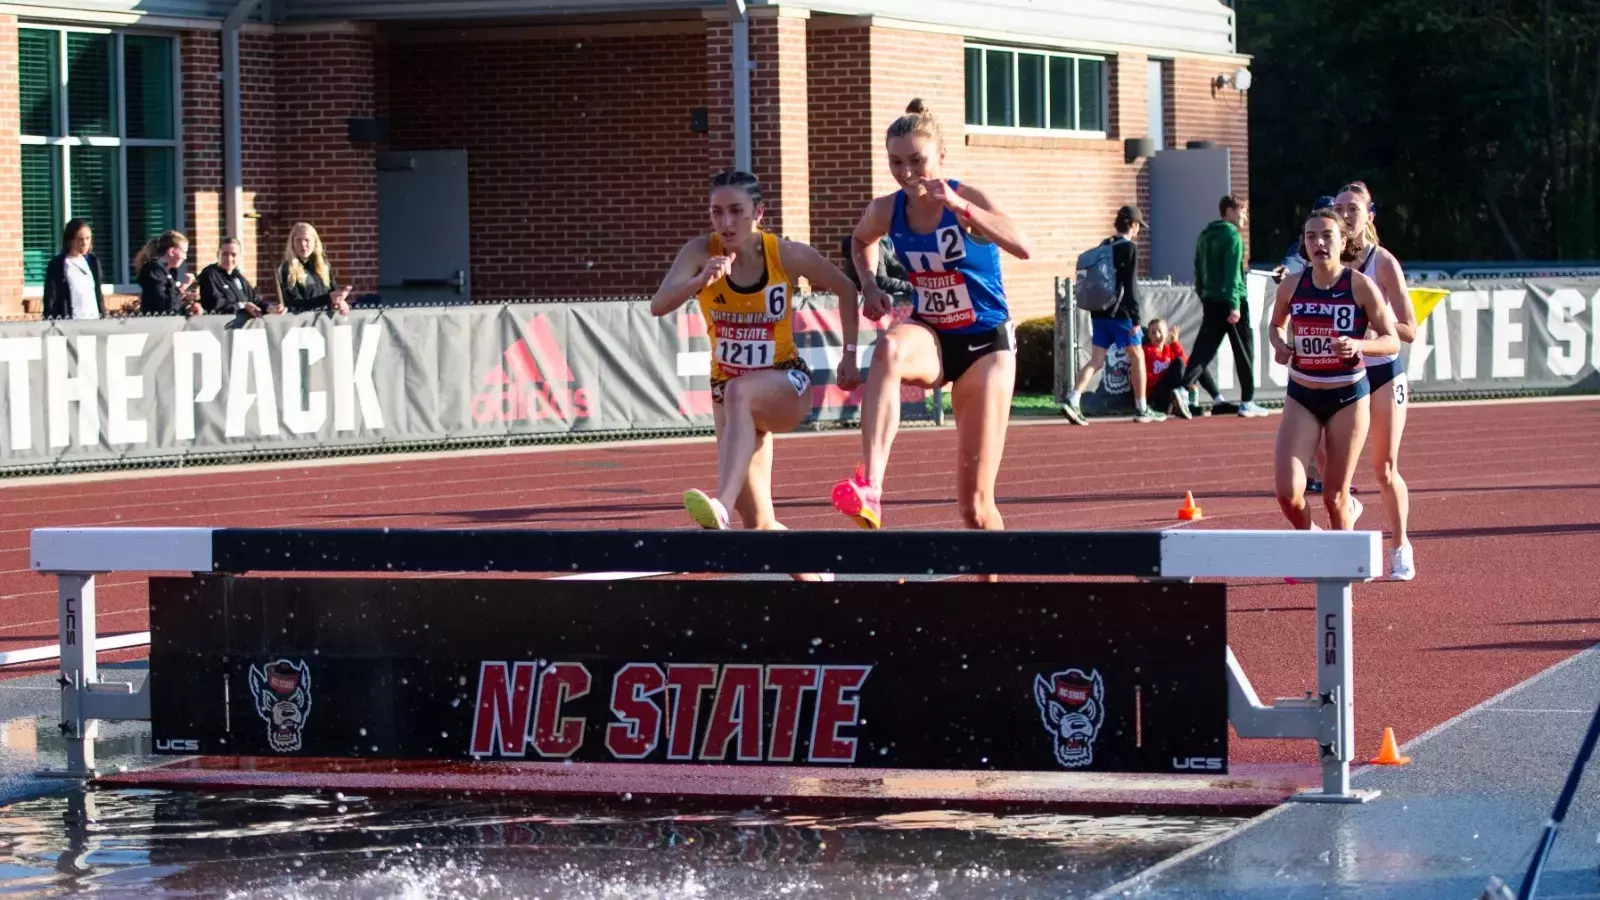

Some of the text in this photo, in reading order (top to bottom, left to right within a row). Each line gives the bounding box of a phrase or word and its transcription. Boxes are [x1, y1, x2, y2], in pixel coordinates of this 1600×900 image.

[941, 229, 963, 260] 2
[928, 274, 957, 289] STATE
[769, 286, 785, 316] 6
[924, 289, 960, 313] 264
[1291, 302, 1335, 315] PEN
[940, 311, 971, 324] adidas
[1336, 306, 1352, 330] 8
[721, 326, 768, 340] NC STATE
[1298, 326, 1333, 336] NC STATE
[1547, 288, 1600, 377] S
[720, 341, 768, 366] 1211
[1301, 337, 1332, 355] 904
[1314, 357, 1340, 365] adidas
[0, 323, 386, 450] THE PACK
[1395, 384, 1406, 405] 3
[65, 598, 76, 646] UCS
[1324, 613, 1337, 666] UCS
[470, 660, 874, 763] NC STATE
[156, 739, 200, 751] UCS
[1172, 757, 1223, 769] UCS
